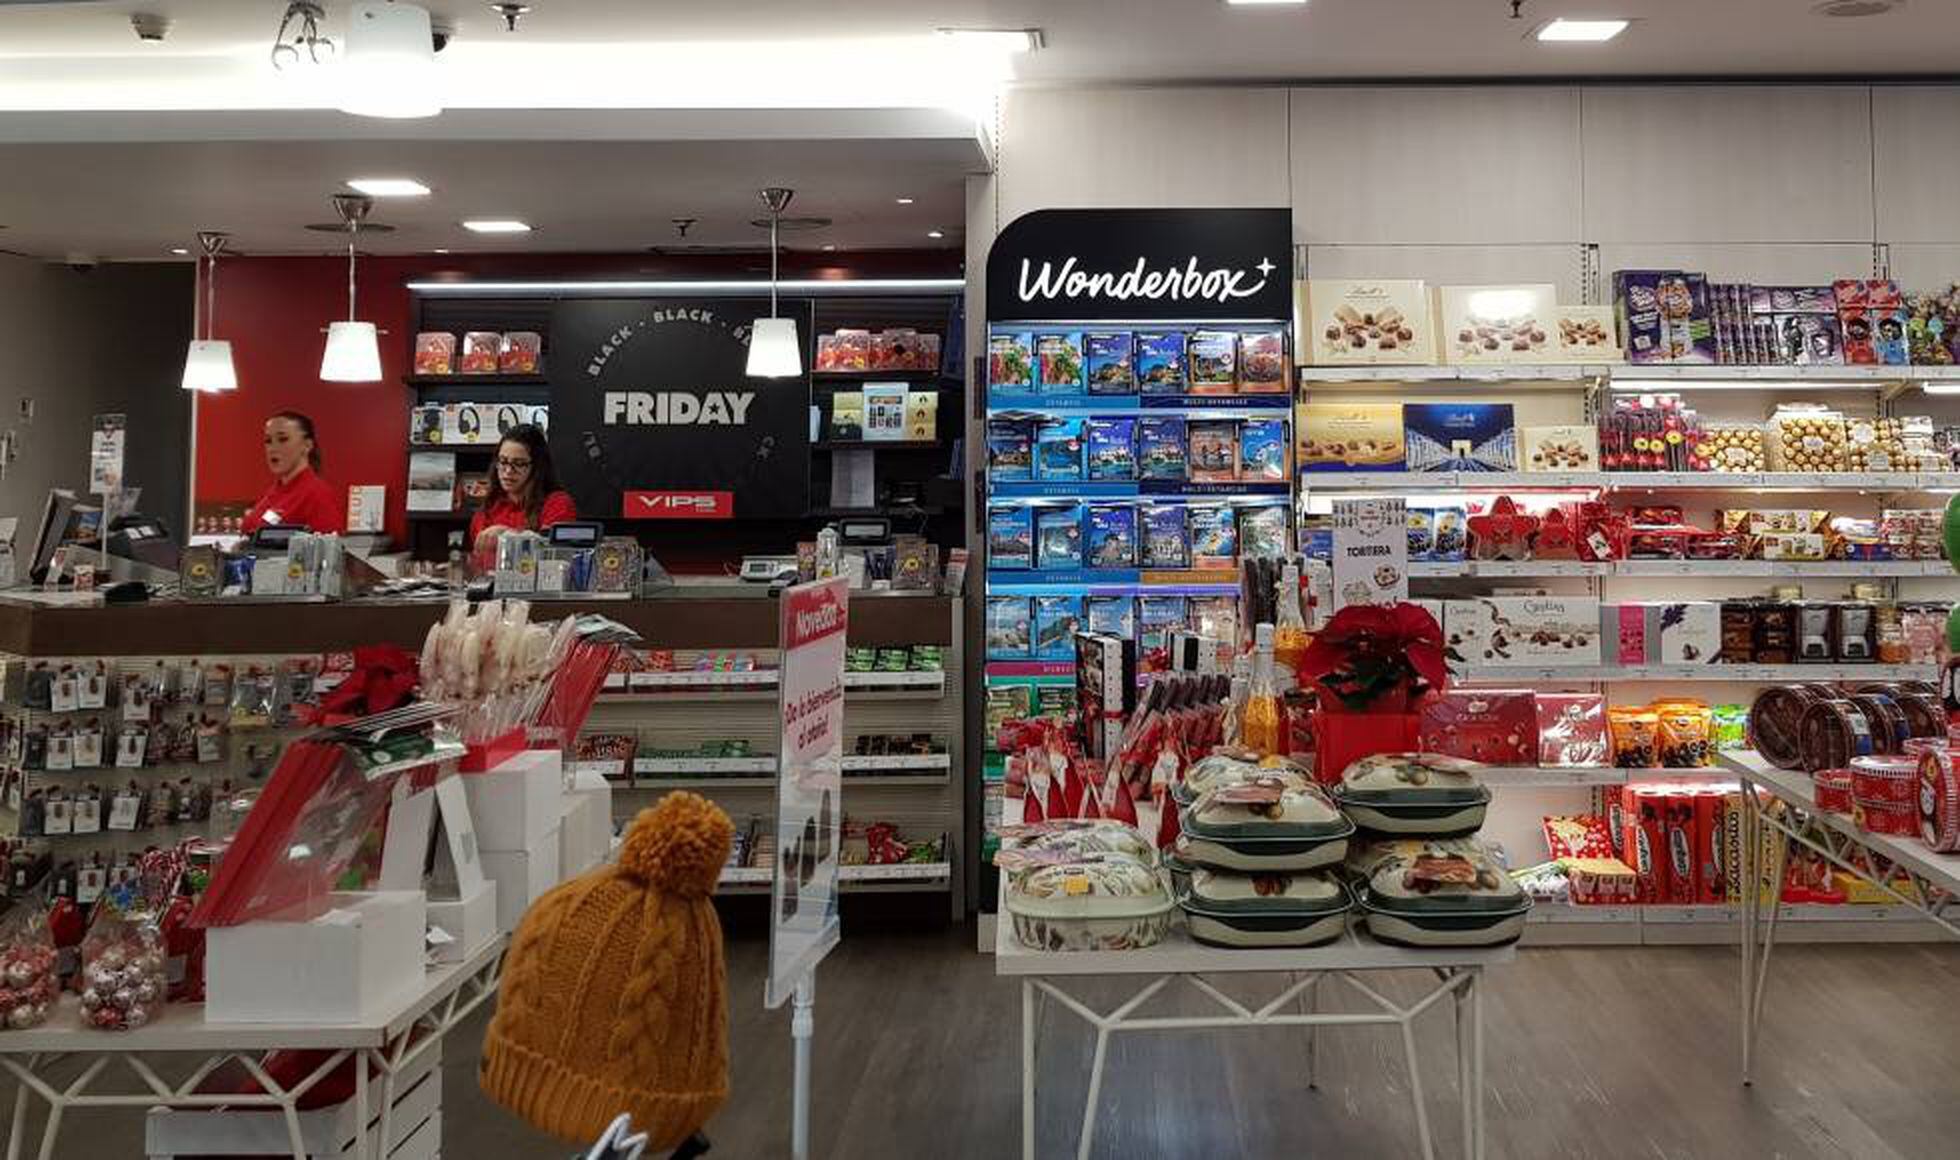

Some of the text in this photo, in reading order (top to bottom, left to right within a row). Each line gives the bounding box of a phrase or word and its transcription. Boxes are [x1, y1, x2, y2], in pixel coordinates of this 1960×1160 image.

[1018, 256, 1266, 303] Wonderbox
[588, 308, 714, 376] BLACK BLACK
[603, 391, 756, 425] FRIDAY
[638, 495, 717, 508] VIPS
